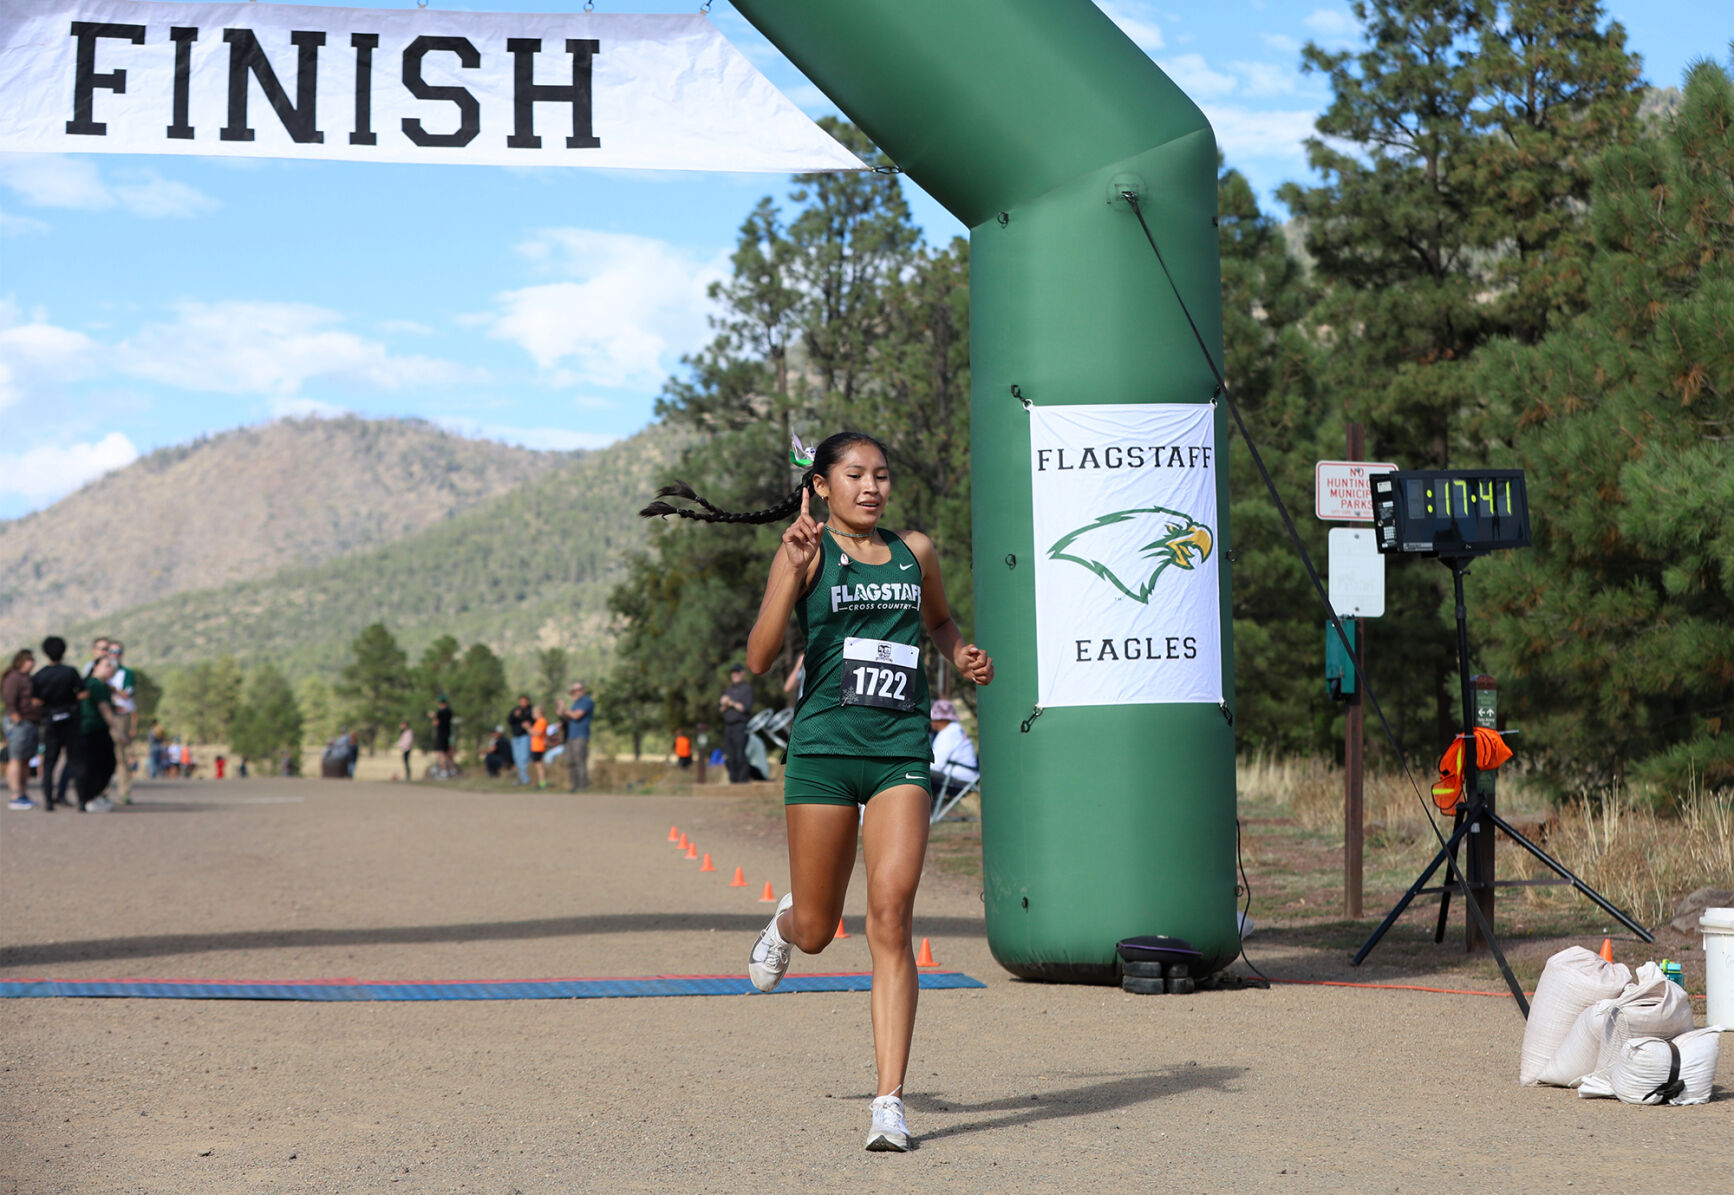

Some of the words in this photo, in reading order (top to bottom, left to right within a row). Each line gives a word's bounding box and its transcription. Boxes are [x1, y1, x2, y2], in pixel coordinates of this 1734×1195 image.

[65, 20, 602, 149] FINISH
[1037, 445, 1213, 472] FLAGSTAFF
[1350, 467, 1365, 478] NO
[1330, 489, 1372, 499] MUNICIP
[1341, 499, 1373, 510] PARKS
[848, 603, 875, 612] CROSS
[877, 603, 913, 611] COUNTRY
[1075, 636, 1197, 662] EAGLES
[852, 666, 908, 701] 1722
